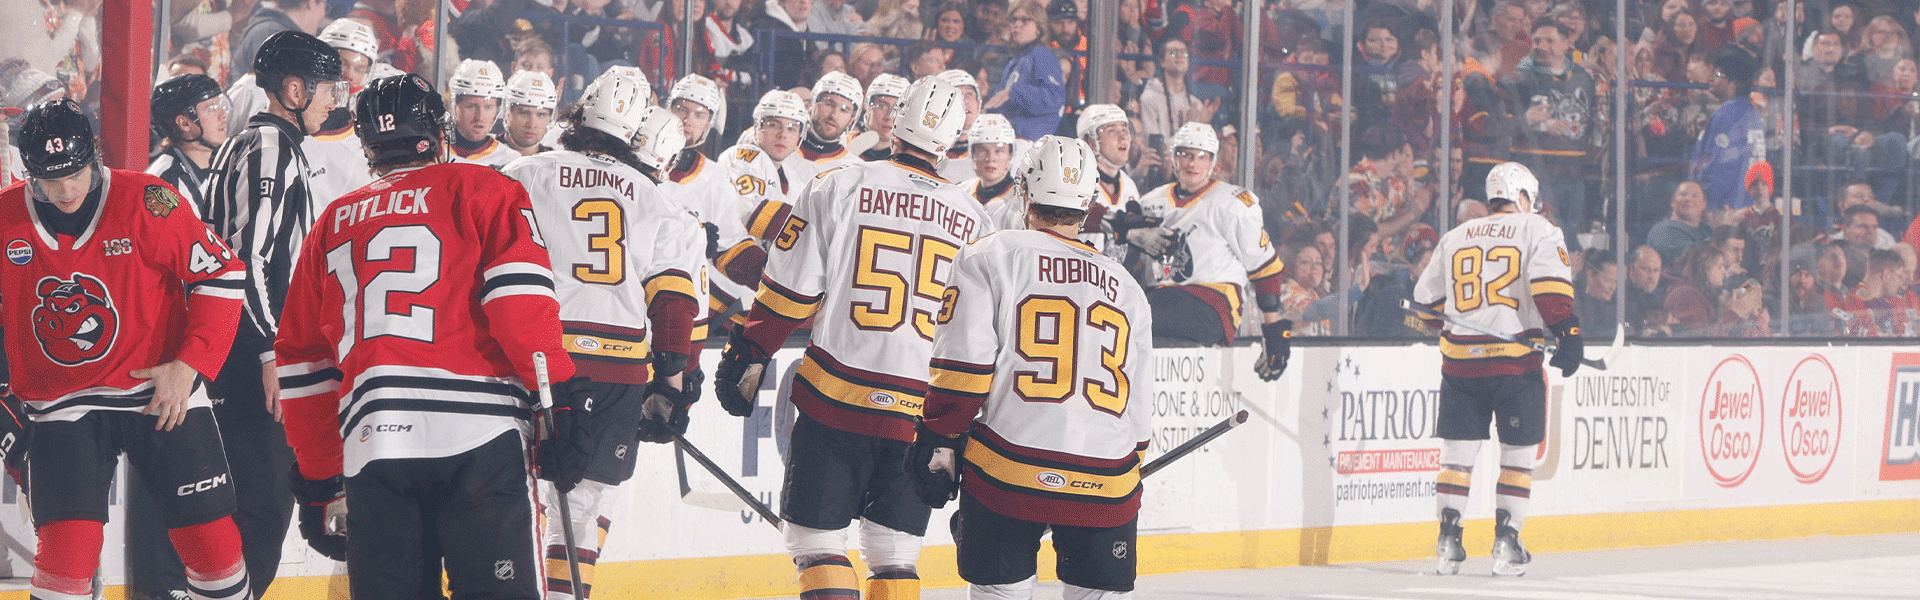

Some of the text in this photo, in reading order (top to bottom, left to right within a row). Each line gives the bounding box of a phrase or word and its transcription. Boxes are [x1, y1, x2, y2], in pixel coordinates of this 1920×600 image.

[378, 113, 395, 132] 12
[922, 111, 940, 129] 55
[45, 137, 64, 154] 43
[47, 160, 72, 172] CCM
[1062, 167, 1079, 184] 93
[260, 179, 275, 196] 91
[560, 166, 635, 201] BADINKA
[736, 174, 766, 196] 37
[334, 187, 432, 234] PITLICK
[859, 187, 976, 244] BAYREUTHER
[572, 198, 626, 287] 3
[1465, 224, 1517, 240] NADEAU
[8, 248, 31, 256] PEPSI
[850, 225, 961, 343] 55
[1038, 255, 1119, 303] ROBIDAS
[1452, 246, 1522, 313] 82
[326, 224, 443, 365] 12
[602, 343, 633, 351] CCM
[1013, 293, 1131, 419] 93
[873, 395, 923, 410] AHL CCM
[1190, 390, 1200, 417] &
[1204, 391, 1242, 417] JOINT
[1576, 375, 1671, 408] UNIVERSITY OF
[1709, 380, 1755, 420] Jewel
[1789, 379, 1833, 418] Jewel
[376, 424, 413, 432] CCM
[1339, 388, 1440, 441] PATRIOT
[1572, 416, 1669, 471] DENVER
[1711, 423, 1751, 460] Osco
[1791, 421, 1829, 458] Osco
[1382, 450, 1440, 470] MAINTENANCE
[177, 473, 227, 496] CCM
[1043, 475, 1104, 490] AHL CCM
[1336, 477, 1437, 506] patriotpavement.ne
